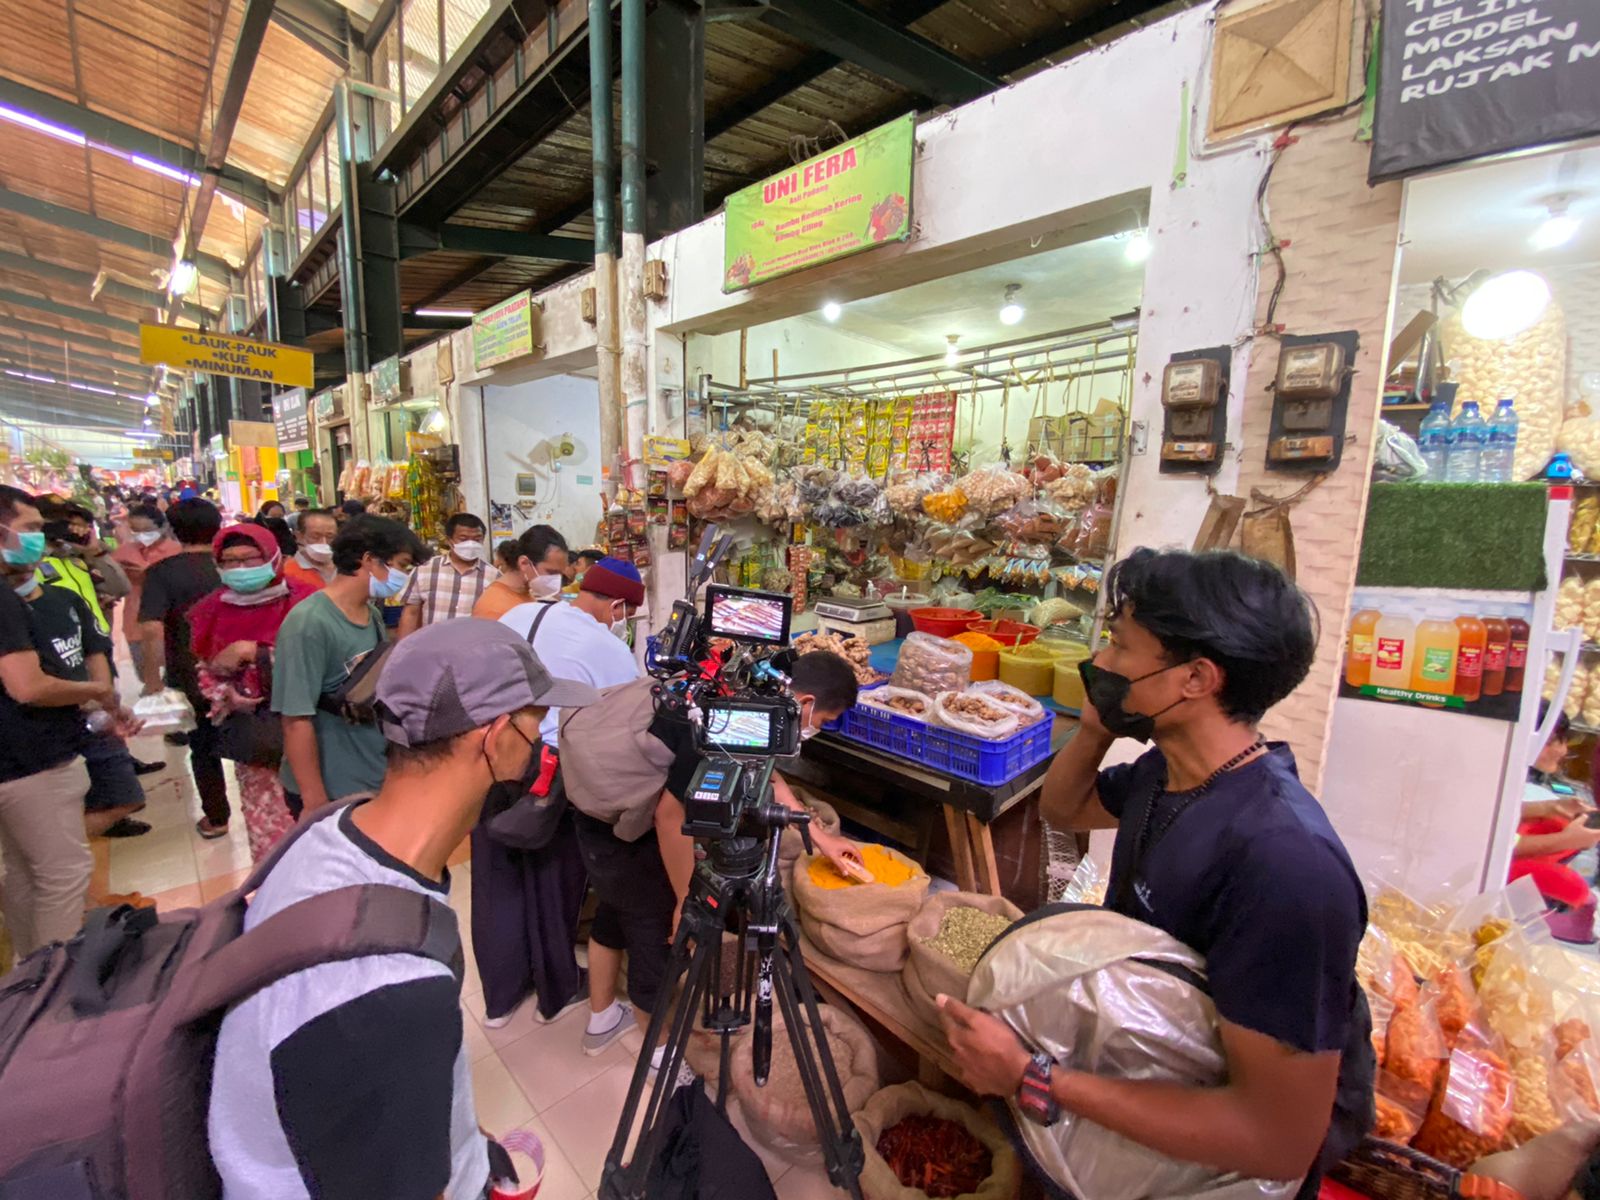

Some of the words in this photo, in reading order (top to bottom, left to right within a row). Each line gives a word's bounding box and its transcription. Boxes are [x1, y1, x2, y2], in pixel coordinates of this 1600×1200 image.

[1402, 21, 1578, 81] LAKSAN
[1403, 8, 1553, 60] MODEL
[1401, 51, 1553, 103] RUJAK
[763, 172, 798, 204] UNI
[803, 147, 857, 188] FERA
[188, 333, 277, 359] LAUK-PAUK
[219, 351, 249, 363] KUE
[192, 358, 273, 380] MINUMAN
[1376, 686, 1414, 699] Healthy
[1414, 691, 1447, 703] Drinks
